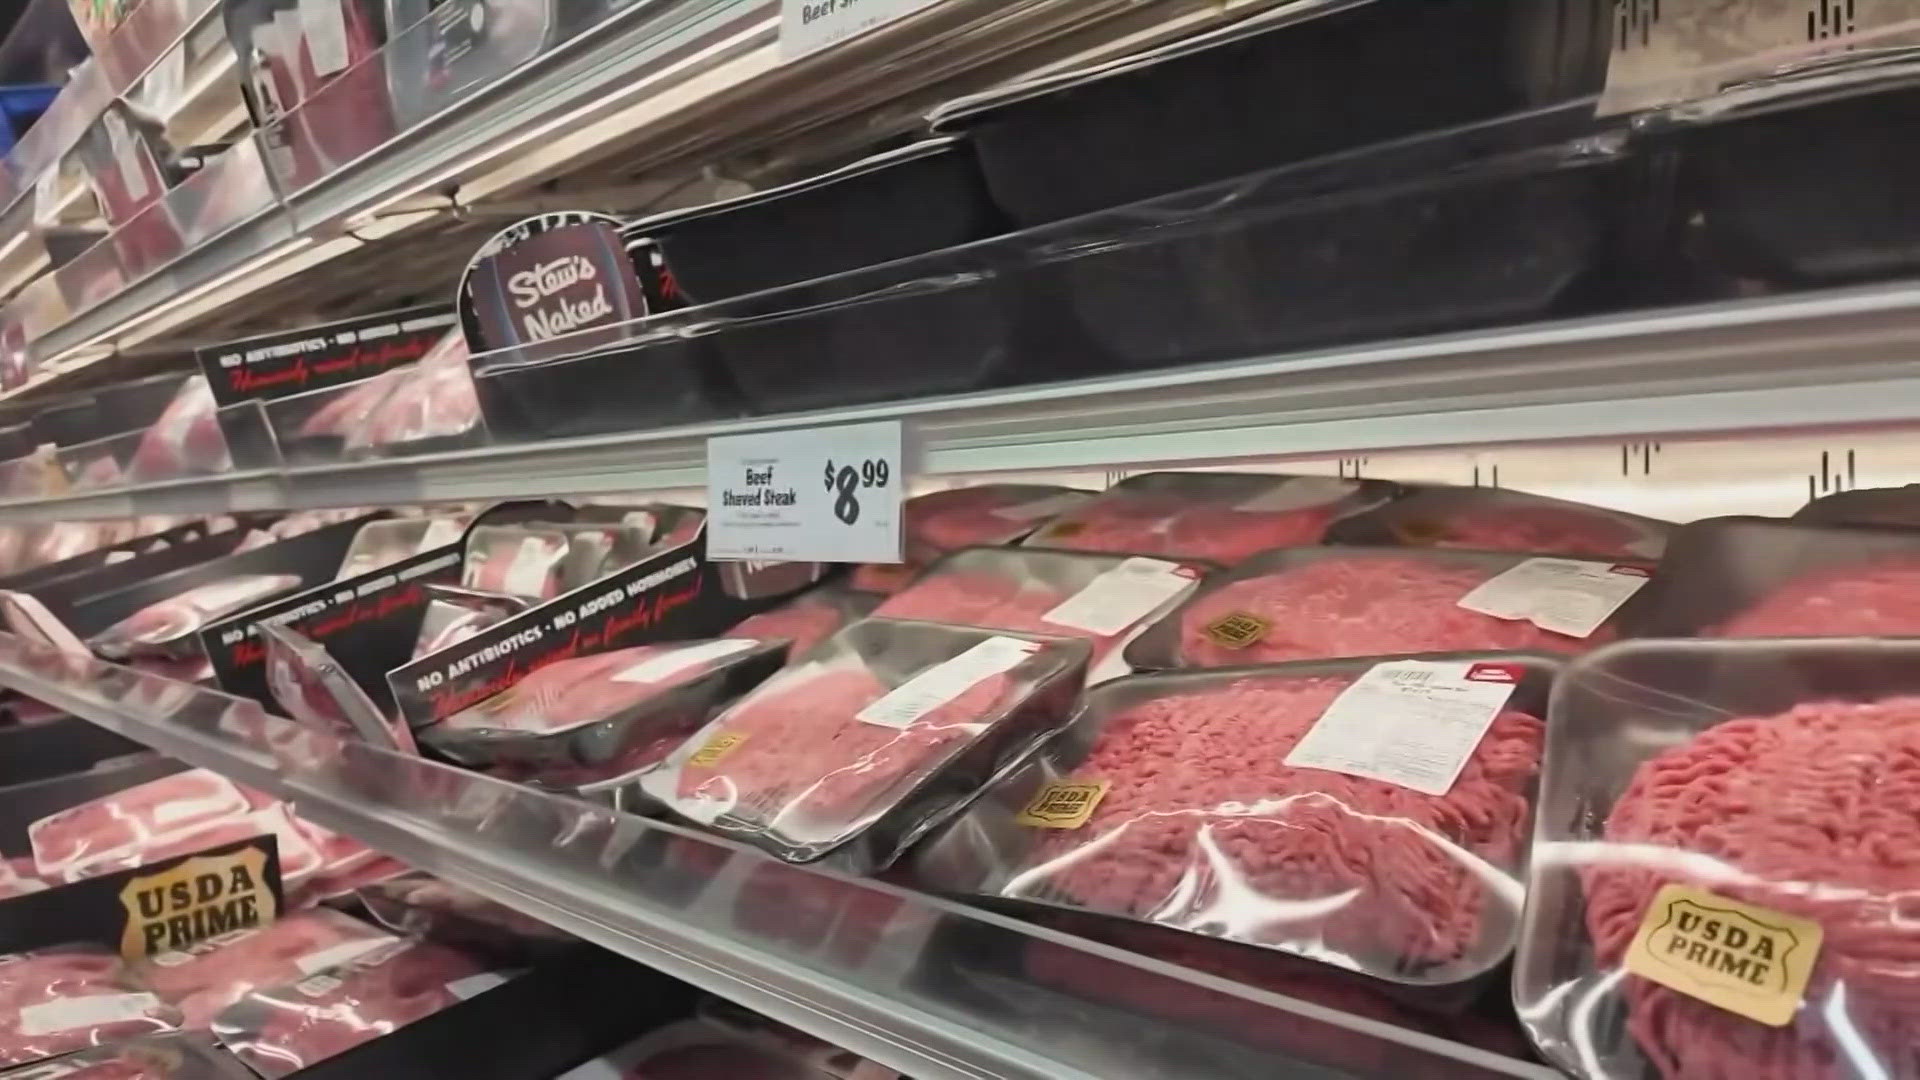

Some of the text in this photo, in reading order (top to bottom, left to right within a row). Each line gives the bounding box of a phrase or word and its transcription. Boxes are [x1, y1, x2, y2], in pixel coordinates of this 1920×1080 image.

[802, 0, 836, 25] Beef
[508, 255, 596, 308] Stew's
[523, 283, 613, 341] Naked
[722, 487, 797, 507] Shaved Steak
[745, 466, 774, 487] Beef
[416, 671, 443, 692] NO
[448, 625, 544, 680] ANTIBIOTICS
[553, 611, 576, 631] NO
[579, 588, 625, 619] ADDED
[137, 865, 255, 919] USDA
[143, 895, 260, 958] PRIME
[1677, 911, 1775, 961] USDA
[1666, 934, 1770, 986] PRIME
